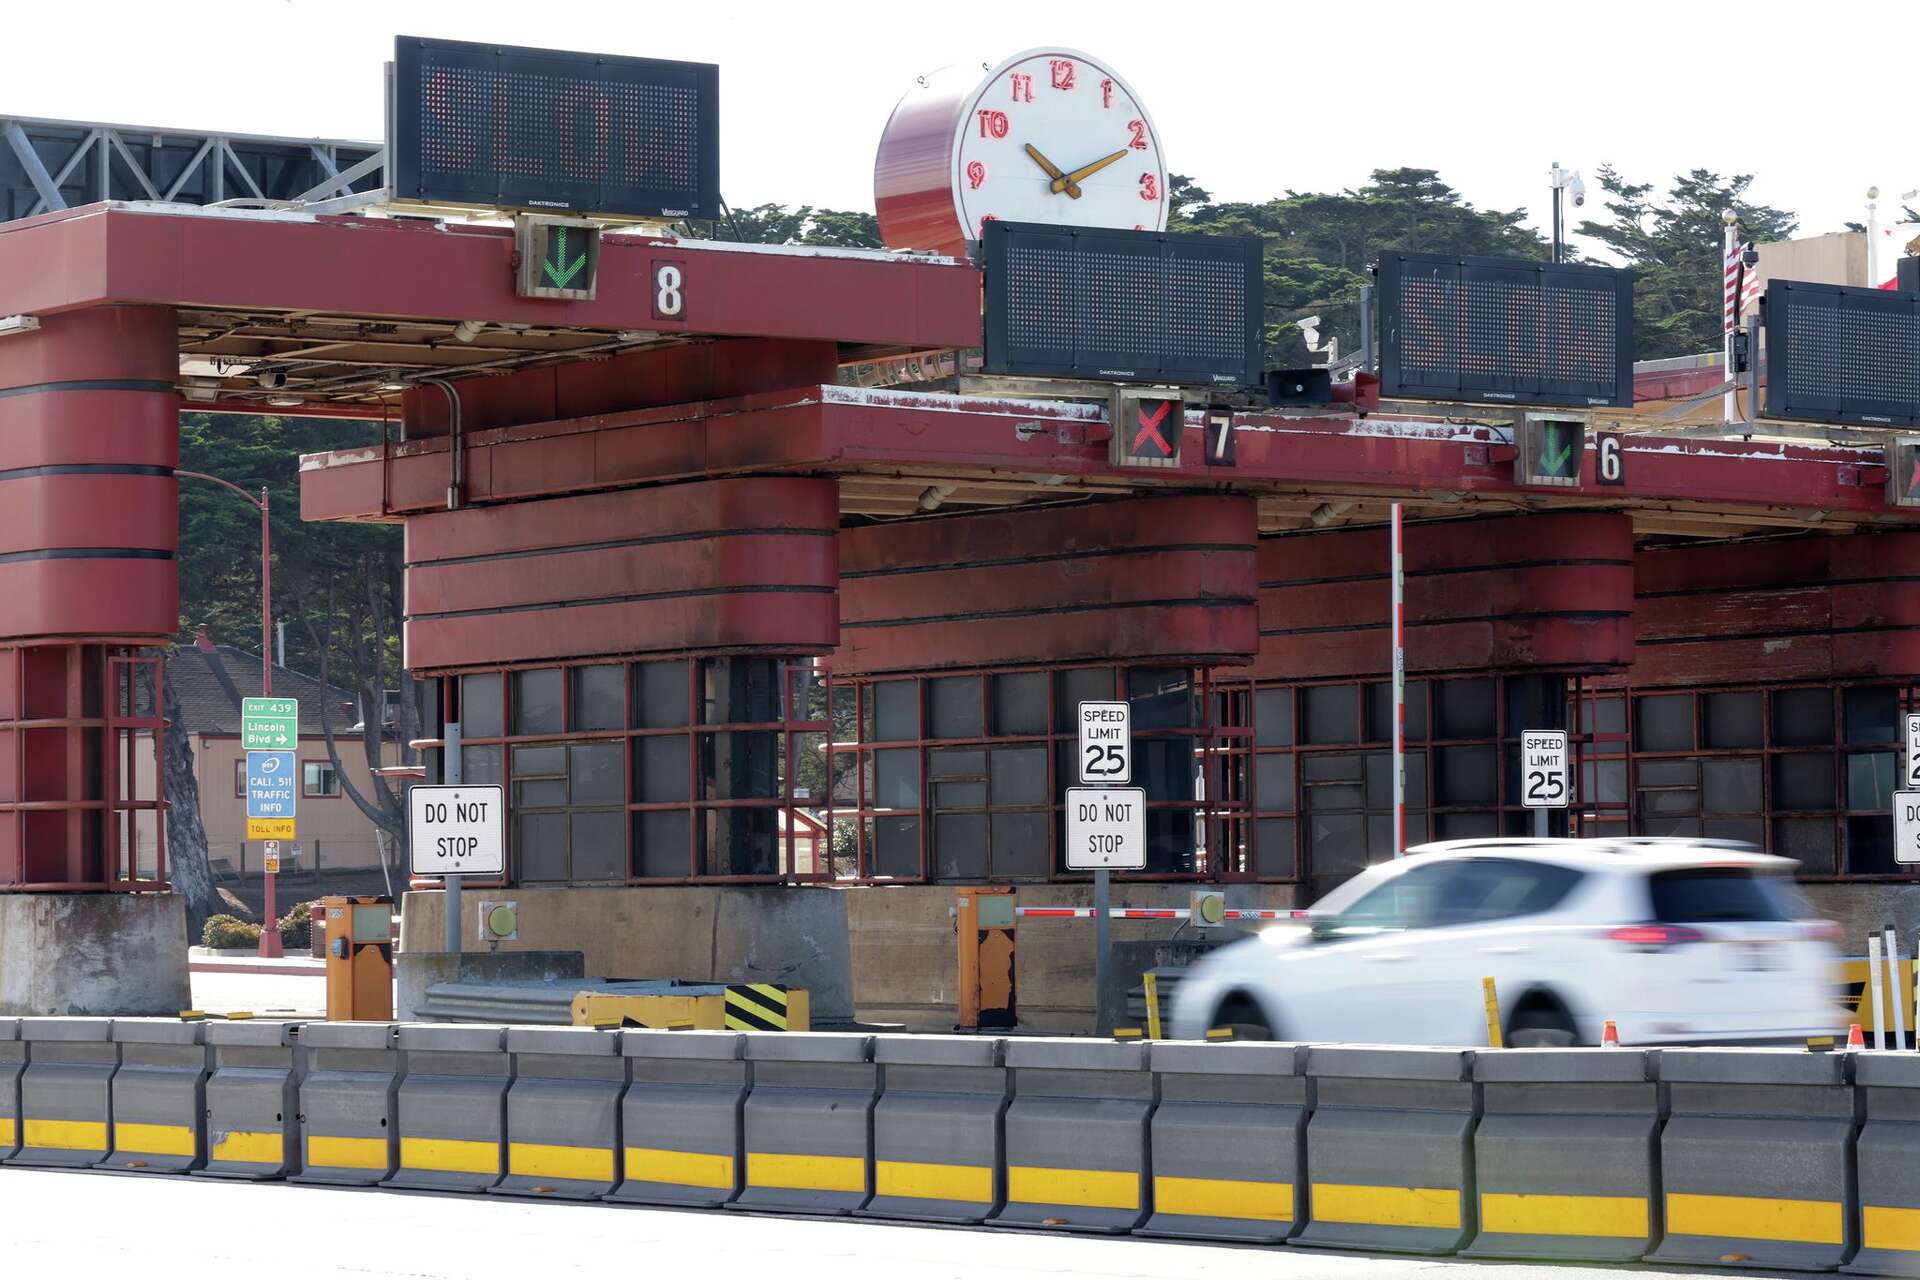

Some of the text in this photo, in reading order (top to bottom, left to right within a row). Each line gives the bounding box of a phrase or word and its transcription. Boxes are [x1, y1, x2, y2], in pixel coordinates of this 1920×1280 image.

[1050, 59, 1075, 90] 12
[1010, 73, 1036, 103] 11
[1101, 78, 1113, 108] 1
[426, 71, 688, 186] SLOW
[977, 109, 1009, 139] 10
[1127, 119, 1149, 149] 2
[967, 160, 985, 190] 9
[1139, 172, 1158, 201] 3
[528, 199, 570, 208] DAKTRONICS
[657, 265, 682, 316] 8
[1404, 282, 1609, 377] SLOW
[1210, 416, 1230, 460] 7
[1601, 437, 1620, 481] 6
[248, 703, 292, 713] EXIT 439
[1083, 710, 1125, 722] SPEED
[248, 722, 286, 732] Lincoln
[1088, 727, 1121, 740] LIMIT
[248, 734, 271, 744] Blvd
[1526, 738, 1563, 750] SPEED
[1085, 744, 1126, 775] 25
[1530, 755, 1560, 767] LIMIT
[278, 777, 292, 787] 511
[1527, 770, 1564, 799] 25
[252, 790, 290, 800] TRAFFIC
[260, 803, 282, 813] INFO
[425, 802, 488, 823] DO NOT
[1079, 804, 1132, 822] DO NOT
[251, 825, 292, 833] TOLL INFO
[436, 836, 478, 857] STOP
[1088, 834, 1124, 854] STOP
